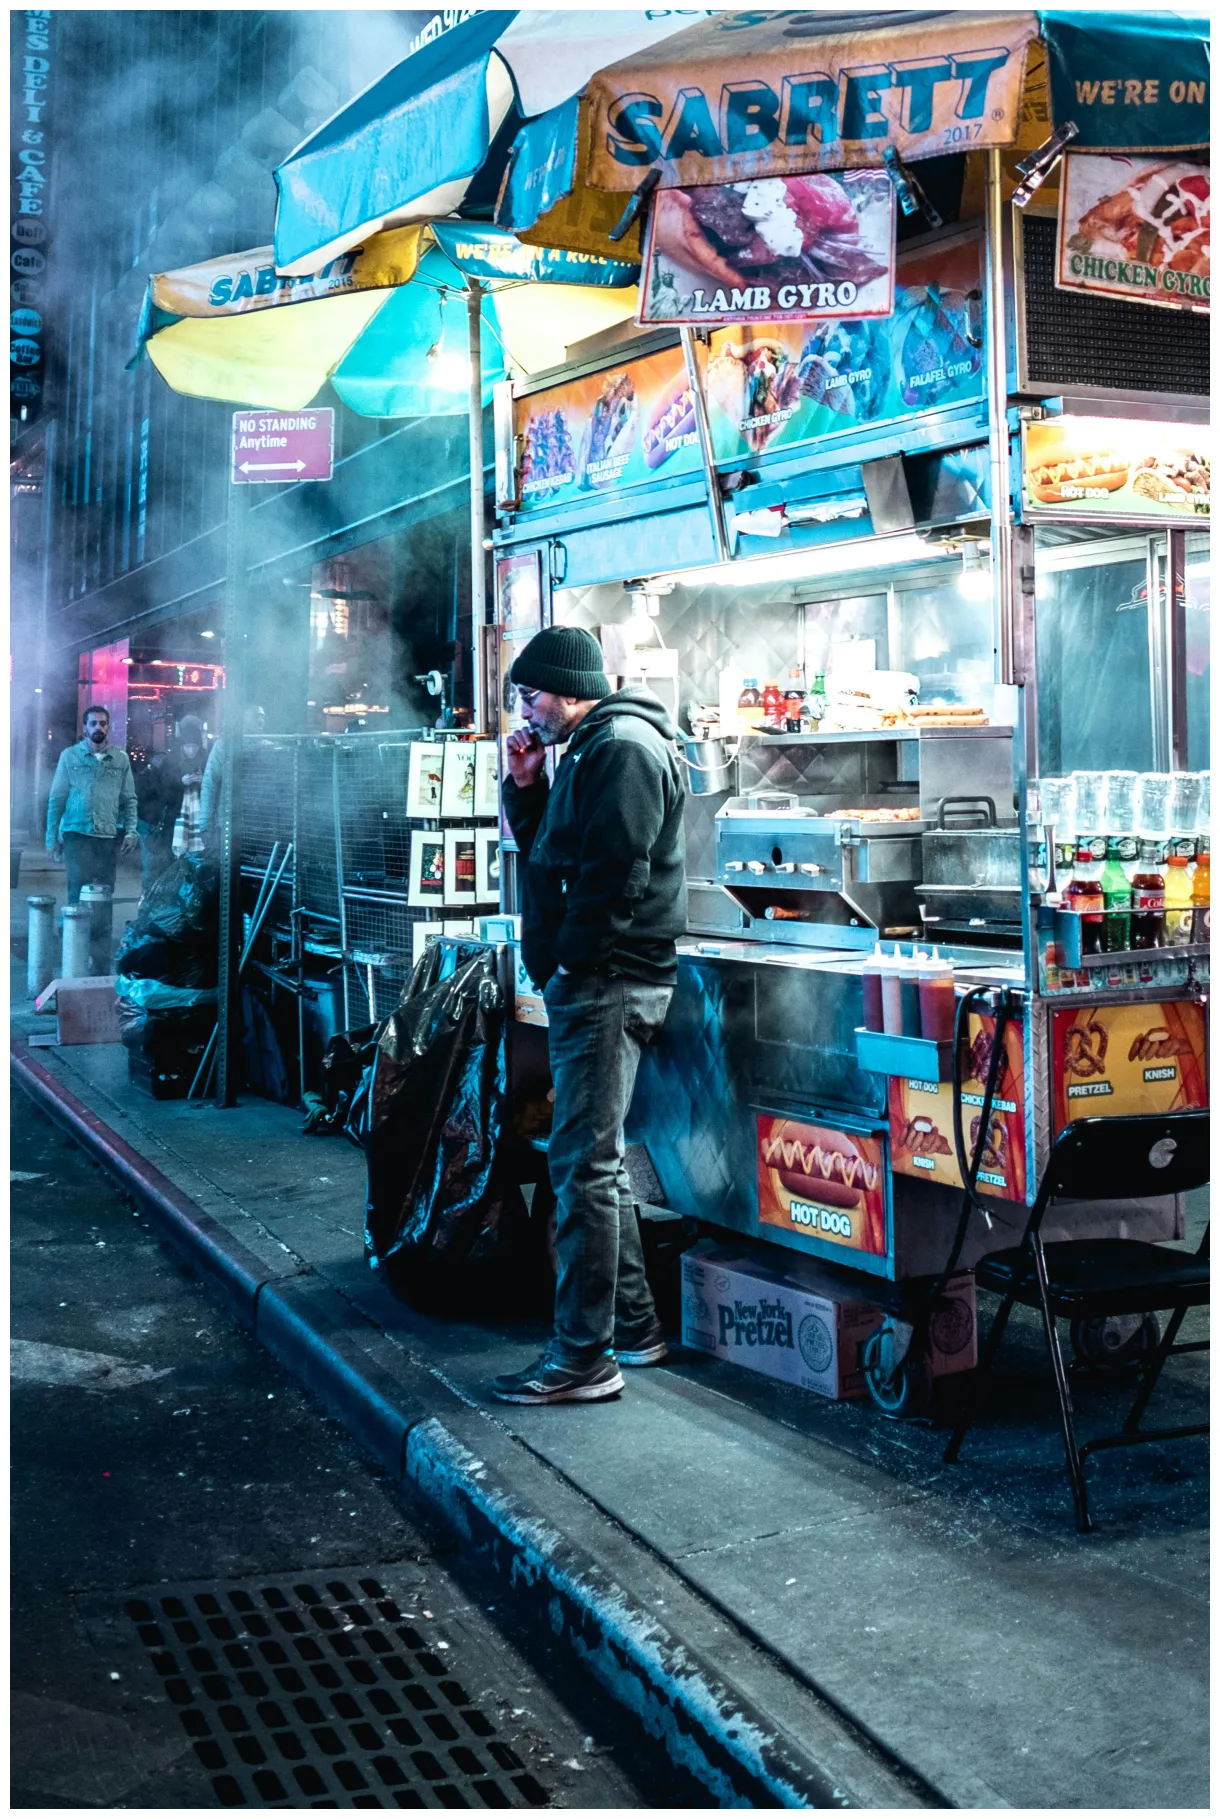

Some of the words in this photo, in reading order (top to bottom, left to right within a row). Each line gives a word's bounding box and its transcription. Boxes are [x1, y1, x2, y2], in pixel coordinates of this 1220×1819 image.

[22, 55, 50, 123] DELI
[1075, 79, 1160, 106] WE'RE
[1169, 80, 1206, 105] ON
[606, 46, 1010, 166] SABRETT
[21, 129, 44, 144] &
[944, 123, 983, 145] 2017
[16, 149, 46, 215] CAFE
[1070, 254, 1158, 288] CHICKEN
[328, 276, 353, 290] 2015
[692, 287, 771, 314] LAMB
[777, 281, 858, 310] GYRO
[825, 375, 849, 390] LAMB
[848, 368, 872, 385] GYRO
[909, 367, 948, 388] FALAFEL
[946, 360, 973, 378] GYRO
[240, 420, 256, 432] NO
[259, 417, 316, 432] STANDING
[738, 415, 773, 432] CHICKEN
[771, 408, 793, 423] GYRO
[239, 435, 288, 451] Anytime
[665, 436, 684, 452] HOT
[587, 457, 612, 474] ITALIAN
[612, 452, 631, 467] BEEF
[591, 467, 623, 484] SAUSAGE
[1060, 485, 1085, 498] HOT
[1085, 486, 1110, 499] DOG
[1144, 1067, 1175, 1080] KNISH
[908, 1079, 923, 1090] HOT
[923, 1082, 938, 1094] DOG
[1068, 1083, 1112, 1097] PRETZEL
[991, 1098, 1017, 1113] KEBAB
[976, 1170, 1008, 1188] PRETZEL
[791, 1202, 819, 1227] HOT
[821, 1210, 851, 1237] DOG
[734, 1301, 757, 1320] New
[758, 1298, 787, 1321] York
[717, 1303, 795, 1350] Pretzel
